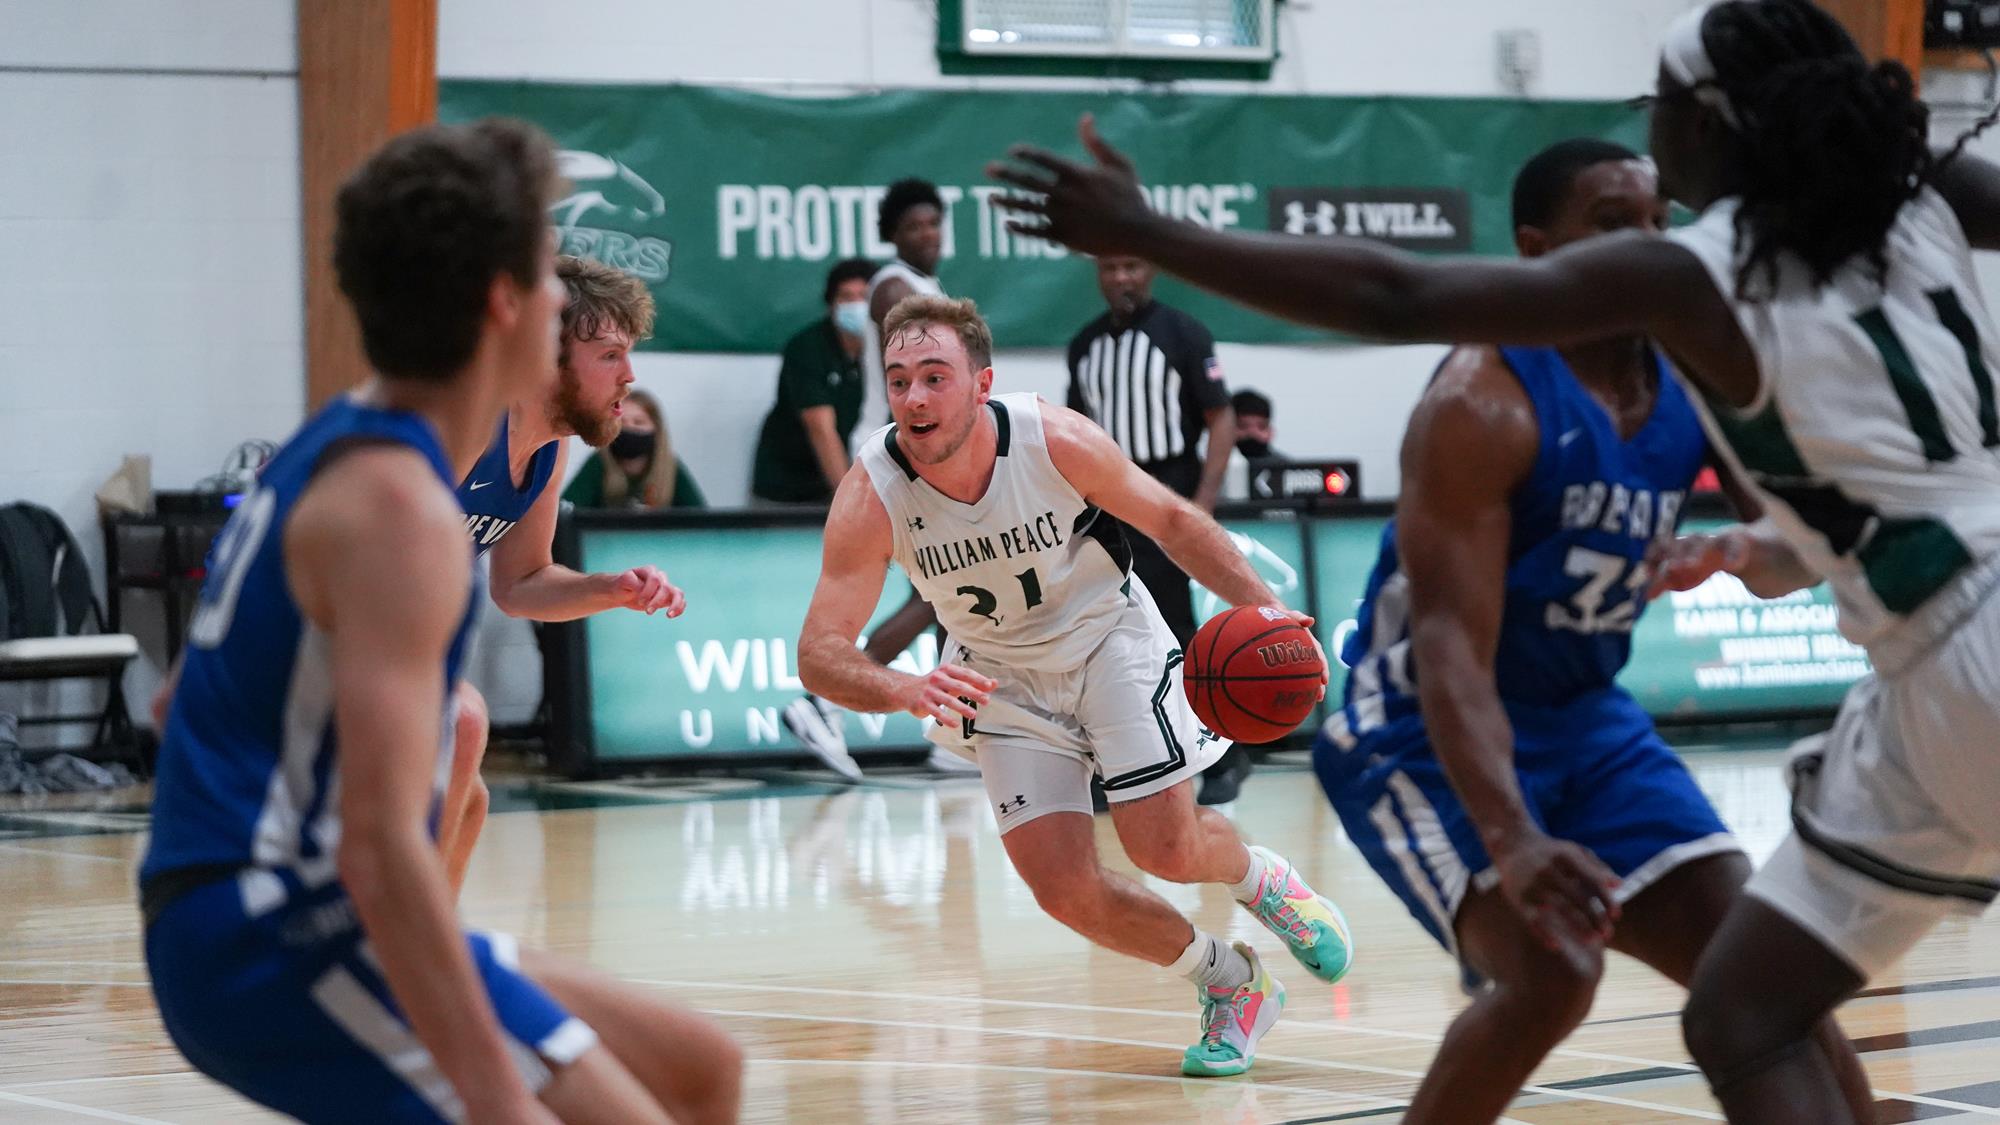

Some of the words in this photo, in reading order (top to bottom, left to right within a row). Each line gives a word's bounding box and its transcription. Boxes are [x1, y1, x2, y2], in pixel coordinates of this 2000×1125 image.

[717, 184, 962, 259] PROTET
[1000, 511, 1063, 558] PEACE
[957, 567, 1043, 627] 21
